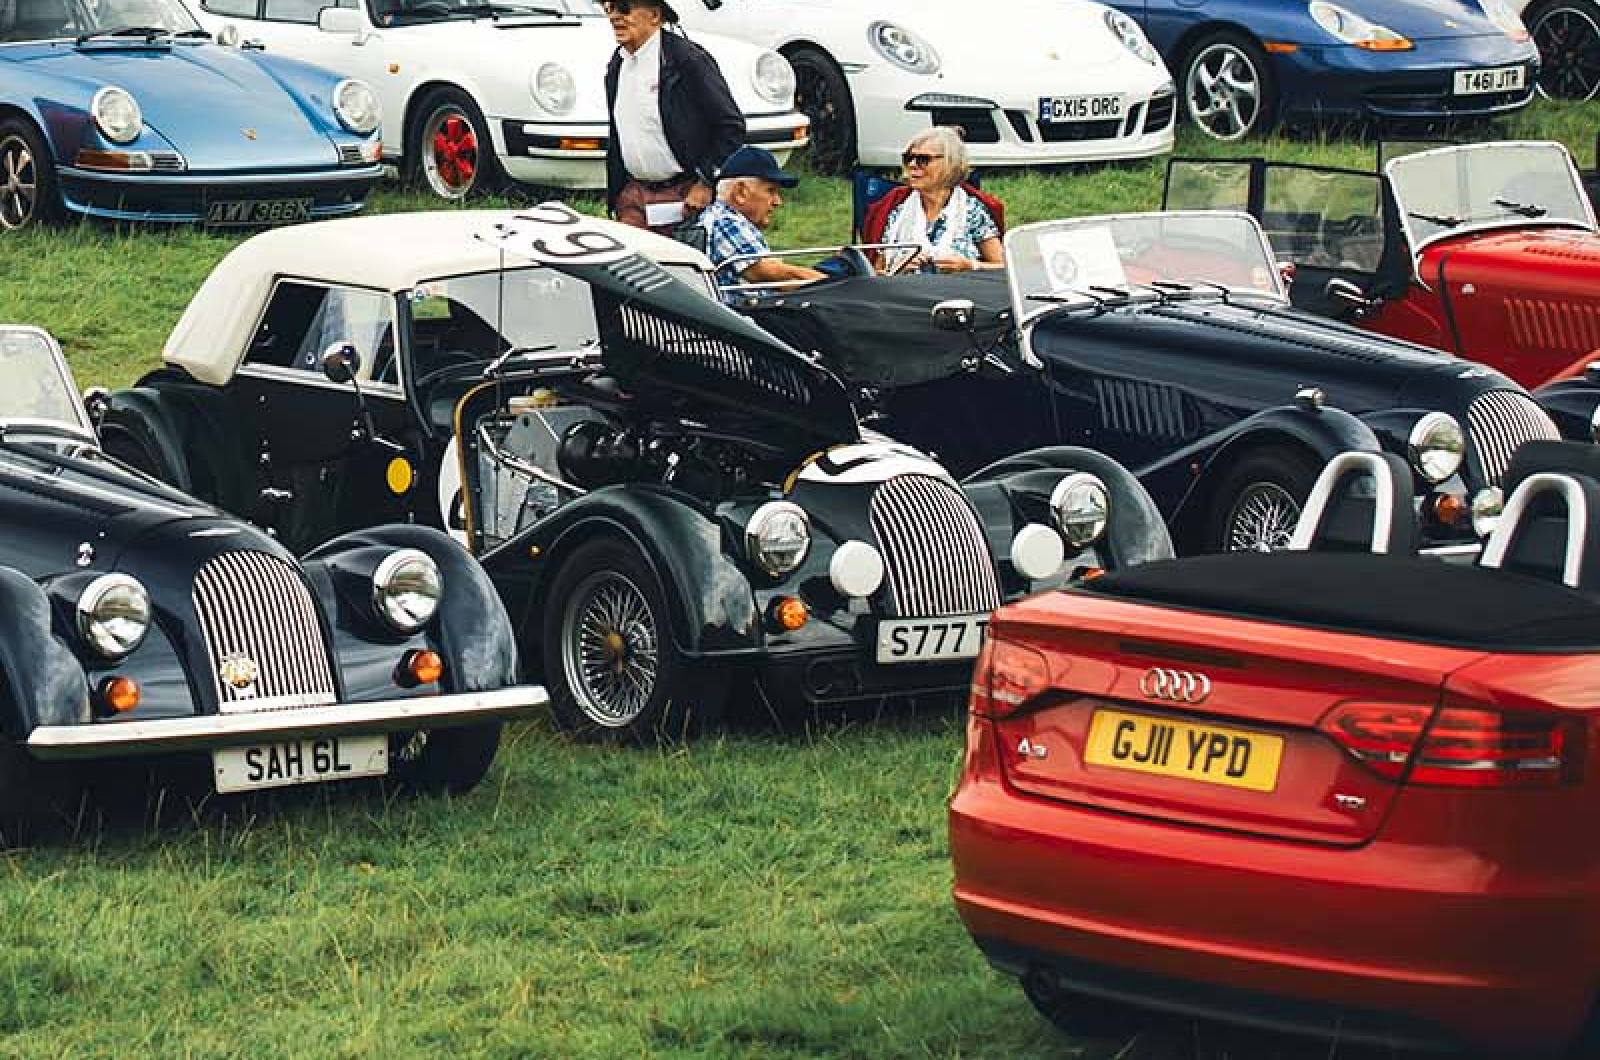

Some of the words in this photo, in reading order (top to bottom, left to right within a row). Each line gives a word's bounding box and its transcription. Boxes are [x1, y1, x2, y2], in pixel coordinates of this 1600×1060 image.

[1463, 72, 1494, 91] T461
[1053, 98, 1087, 118] GX15
[1091, 97, 1120, 116] ORG
[891, 625, 967, 656] S777
[245, 743, 303, 781] SAH
[314, 739, 352, 773] 6L
[1111, 719, 1175, 768] GJ11
[1187, 729, 1252, 779] YPD
